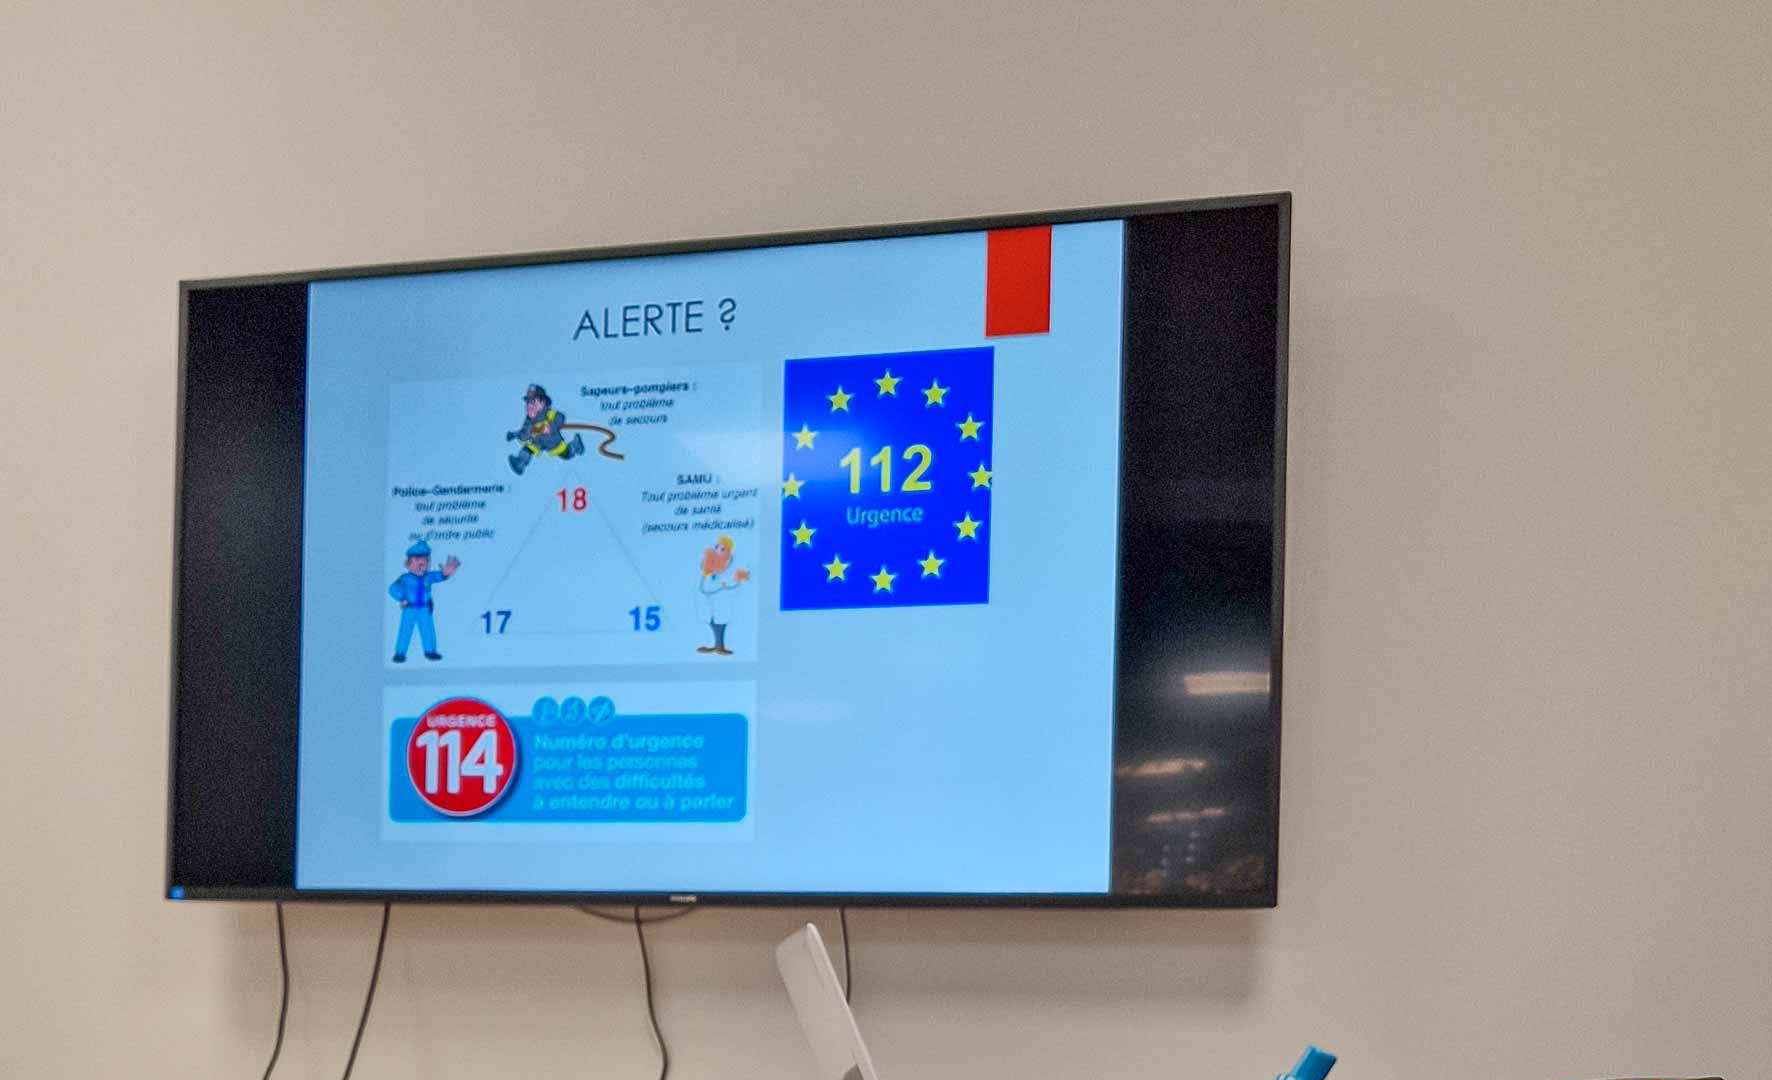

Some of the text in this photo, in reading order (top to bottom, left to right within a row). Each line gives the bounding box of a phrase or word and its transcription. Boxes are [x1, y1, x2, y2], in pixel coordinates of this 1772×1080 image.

[572, 297, 737, 341] ALERTE ?
[840, 444, 932, 494] 112
[676, 474, 712, 485] SAMU
[555, 488, 587, 512] 18
[846, 506, 923, 528] Urgence
[480, 605, 661, 634] 17 15
[426, 714, 497, 729] URGENCE
[534, 733, 705, 751] Numéro d'urgence
[416, 728, 504, 795] 114
[533, 754, 698, 772] pour les personnes
[533, 772, 705, 790] avec des difficultés
[550, 796, 630, 810] entendre
[635, 797, 660, 809] ou
[680, 795, 735, 812] parler
